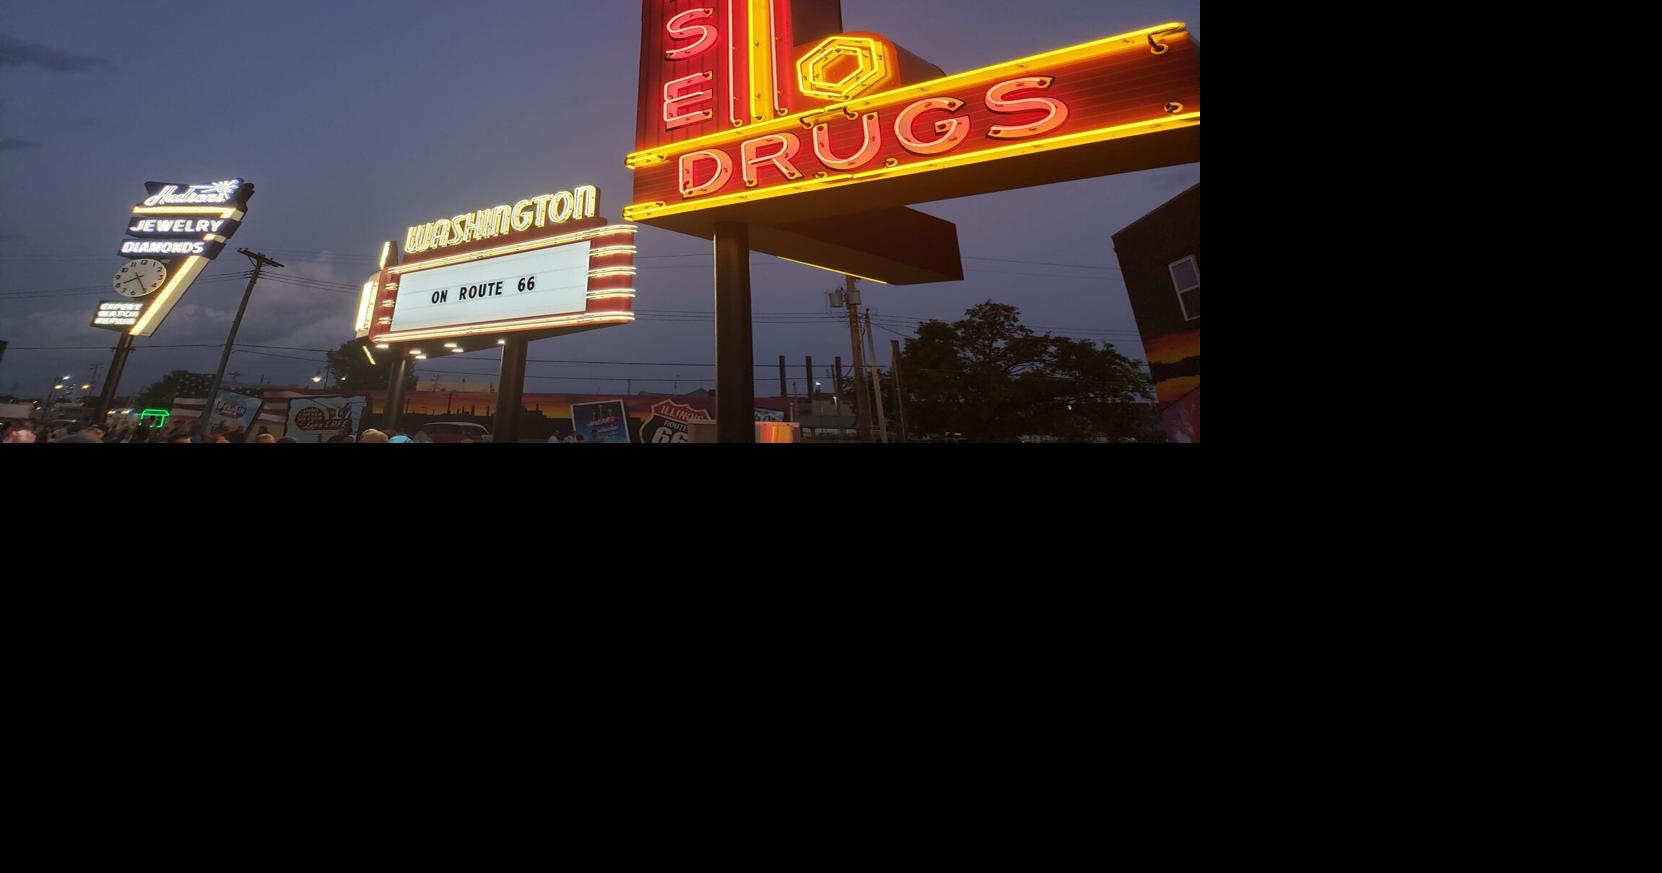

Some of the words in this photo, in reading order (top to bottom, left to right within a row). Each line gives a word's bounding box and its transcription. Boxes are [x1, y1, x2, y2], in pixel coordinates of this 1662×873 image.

[677, 75, 1069, 199] DRUGS
[129, 219, 225, 233] JEWELRY
[404, 184, 598, 254] WASHINGTON
[121, 241, 205, 254] DIAMONDS
[431, 289, 448, 304] ON
[459, 281, 503, 300] ROUTE
[517, 276, 535, 292] 66
[660, 405, 704, 421] ILLINOIS
[663, 419, 688, 431] ROUTE
